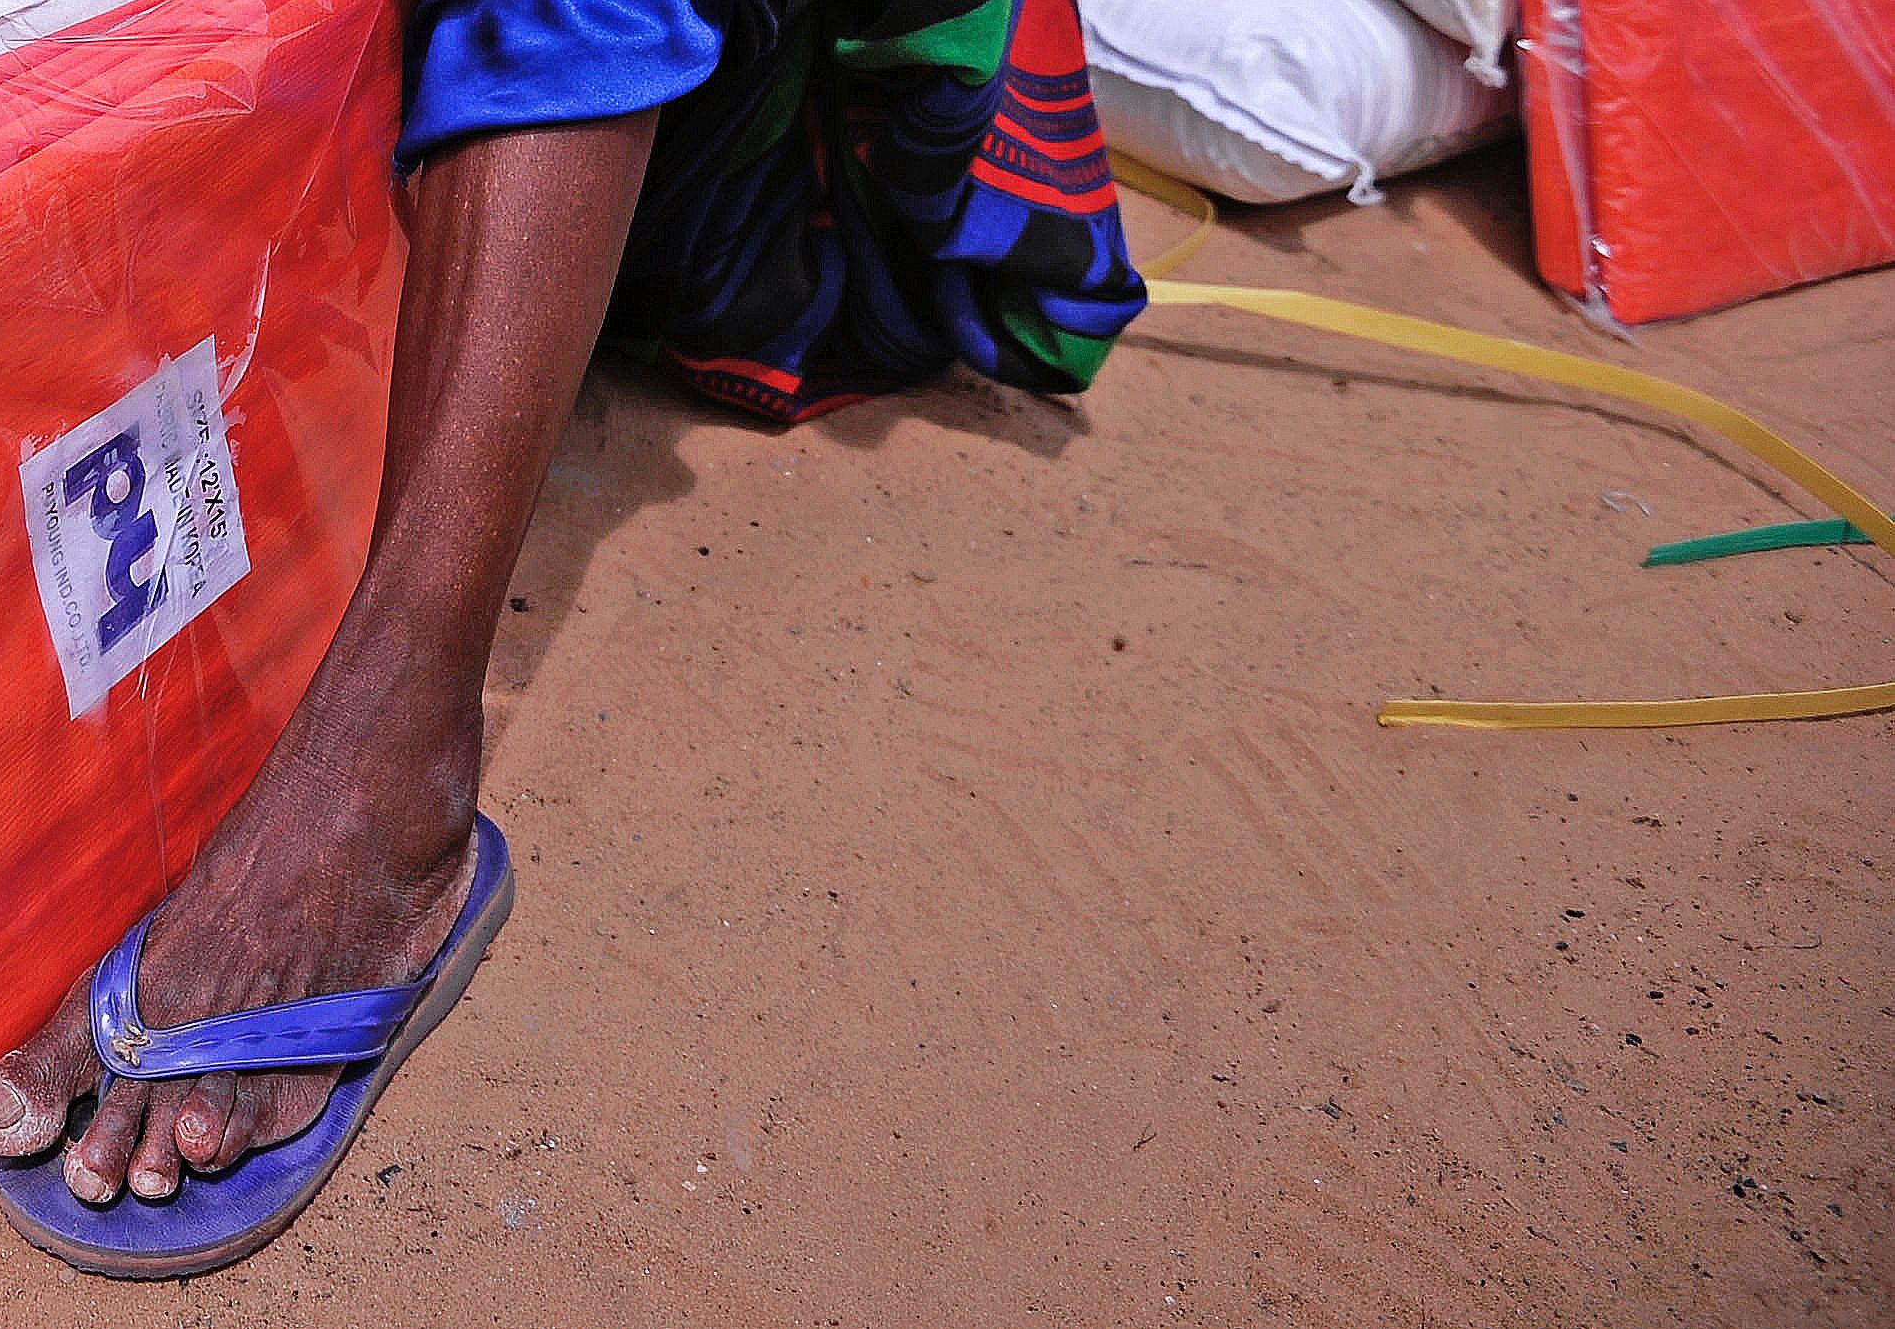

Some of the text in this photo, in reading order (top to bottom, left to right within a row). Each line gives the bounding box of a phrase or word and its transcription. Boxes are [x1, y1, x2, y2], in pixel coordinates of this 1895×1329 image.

[163, 455, 191, 509] MADE
[176, 505, 195, 528] IN
[183, 527, 207, 599] KOREA
